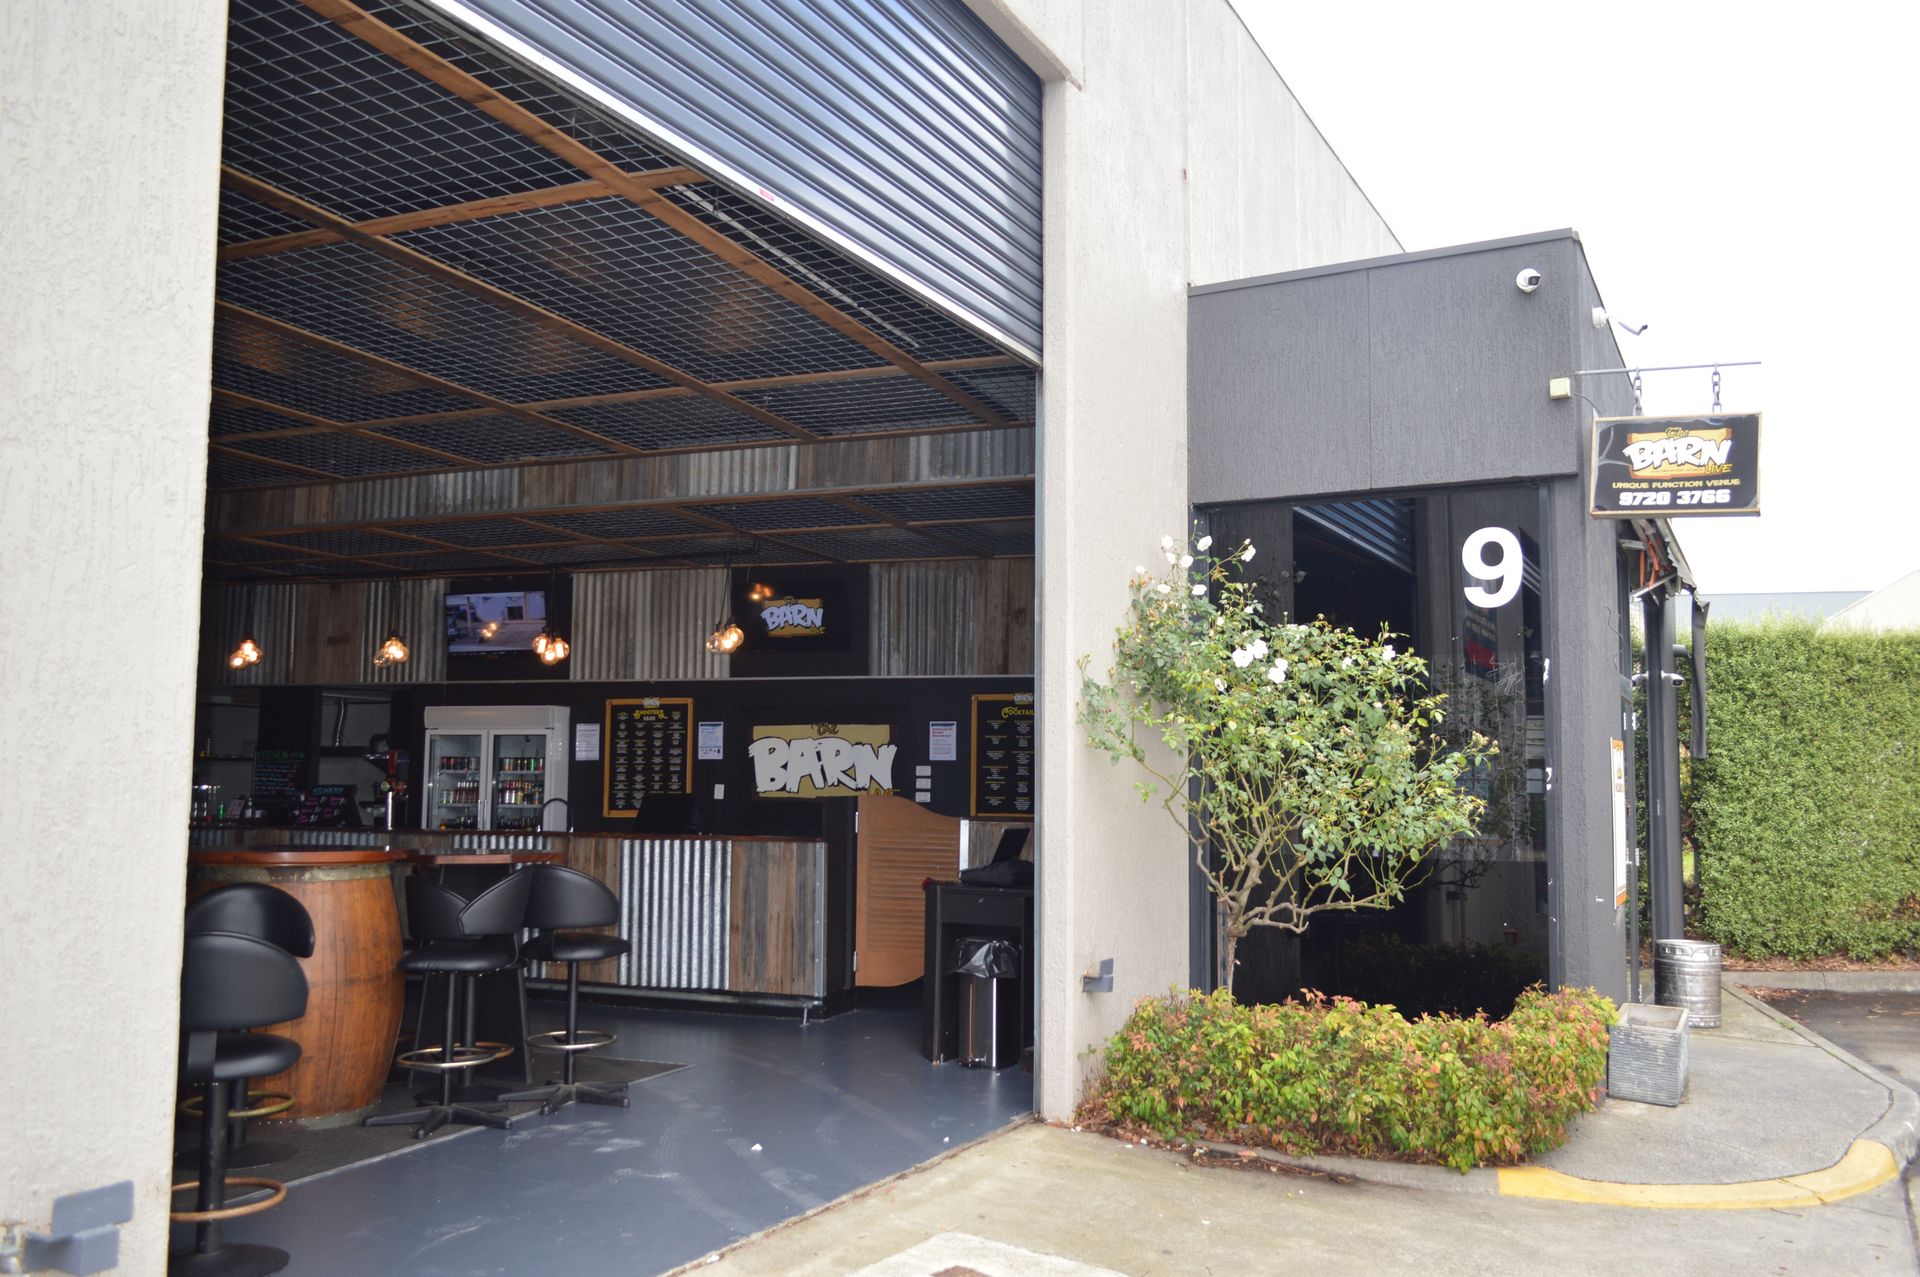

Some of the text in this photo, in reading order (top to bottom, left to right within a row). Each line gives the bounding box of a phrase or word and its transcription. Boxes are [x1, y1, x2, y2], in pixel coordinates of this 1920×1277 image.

[1665, 427, 1690, 438] The
[1622, 436, 1732, 472] BARN
[1704, 463, 1733, 476] LIVE
[1611, 478, 1741, 489] UNIQUE FUNCTION VENUE
[1618, 489, 1731, 506] 9720 3766
[1461, 526, 1524, 609] 9
[760, 604, 824, 631] BARN
[1002, 706, 1035, 719] COCKTAIL
[748, 735, 898, 794] BARN
